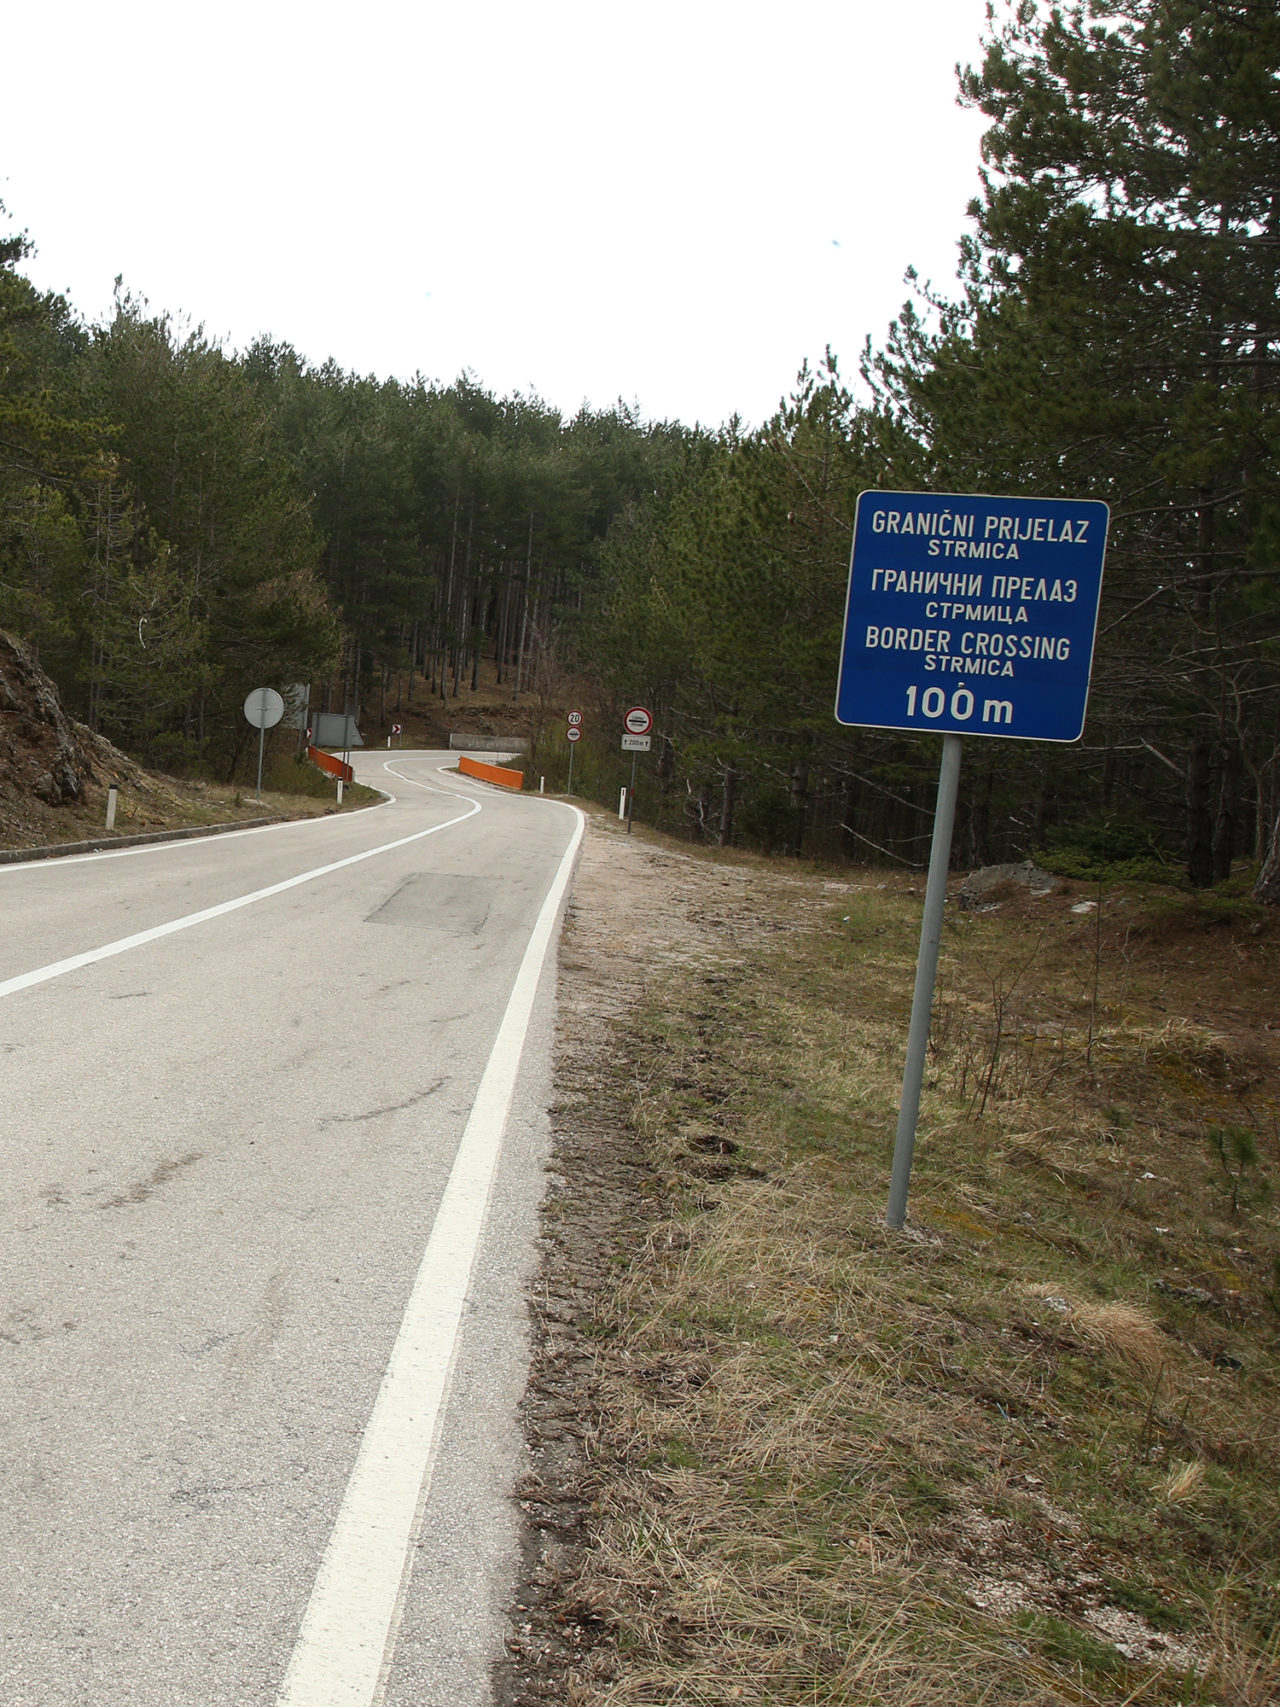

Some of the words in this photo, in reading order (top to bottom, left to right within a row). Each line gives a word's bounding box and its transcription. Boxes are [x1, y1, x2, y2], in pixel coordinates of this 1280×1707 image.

[872, 509, 974, 537] GRANIČNI
[984, 516, 1090, 543] PRIJELAZ
[927, 539, 1019, 559] STRMICA
[871, 568, 982, 597] ГРАНИЧНИ
[991, 575, 1078, 602] ПРЕЛАЗ
[925, 601, 1028, 624] СТРМИЦА
[865, 626, 950, 652] BORDER
[961, 632, 1070, 661] CROSSING
[924, 655, 1014, 677] STRMICA
[570, 714, 580, 723] 20
